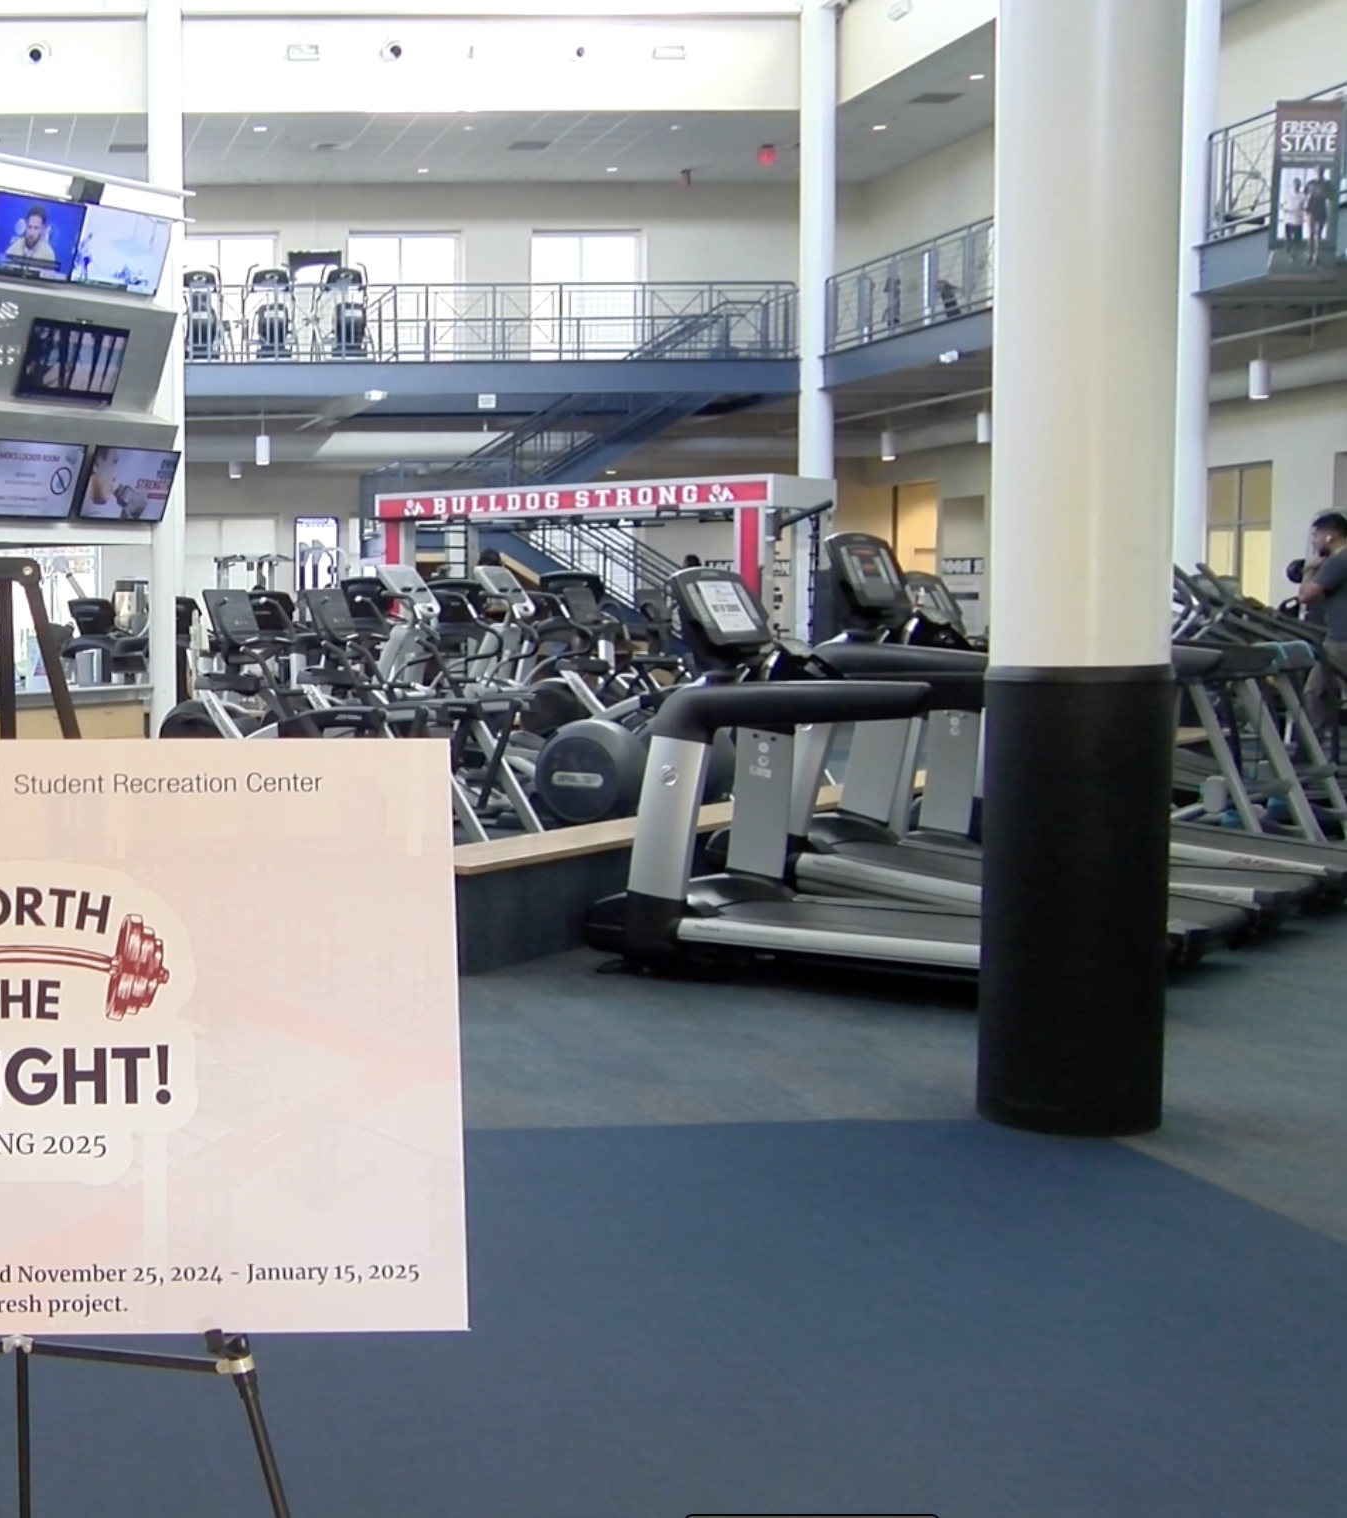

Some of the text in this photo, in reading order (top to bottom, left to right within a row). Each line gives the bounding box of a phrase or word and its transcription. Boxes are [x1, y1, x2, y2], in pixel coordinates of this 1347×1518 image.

[1282, 121, 1338, 134] FRESNO
[1281, 134, 1337, 152] STATE
[433, 485, 698, 514] BULLDOG STRONG
[14, 774, 104, 795] Student
[113, 773, 237, 794] Recreation
[246, 772, 322, 793] Center
[42, 1135, 107, 1158] 2025
[17, 1263, 127, 1284] November
[133, 1267, 165, 1286] 25,
[170, 1265, 223, 1285] 2024
[246, 1263, 329, 1285] January
[333, 1264, 363, 1285] 15,
[368, 1264, 420, 1282] 2025
[47, 1293, 129, 1318] project.
